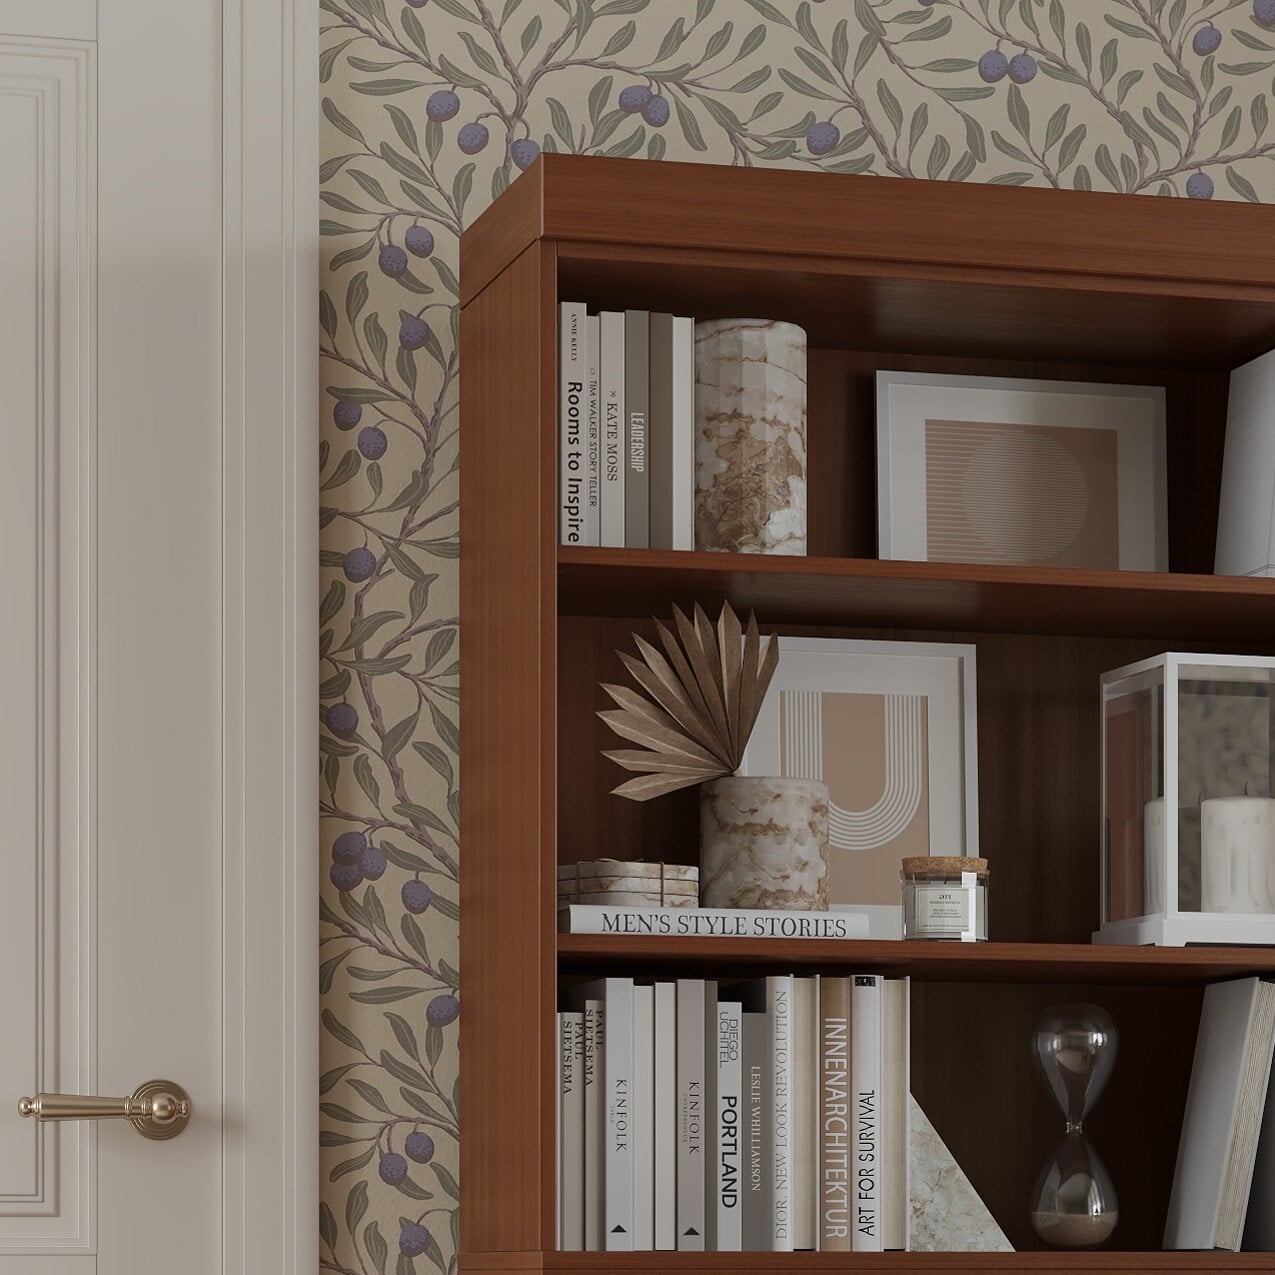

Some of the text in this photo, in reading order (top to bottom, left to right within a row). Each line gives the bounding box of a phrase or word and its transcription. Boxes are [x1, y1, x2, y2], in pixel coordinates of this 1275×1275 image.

[564, 381, 583, 543] Rooms to Inspire
[589, 380, 597, 507] TIM WALKER STORY TELLER
[607, 402, 617, 481] KATE MOSS
[631, 412, 644, 472] LEADERSHIP
[677, 914, 847, 937] STYLE STORIES
[563, 1021, 572, 1094] SIETSEMA
[575, 1022, 583, 1059] PAUL
[585, 1009, 593, 1085] SIETSEMA
[595, 1010, 603, 1049] PAUL
[729, 1019, 738, 1060] DIEGO
[616, 1079, 626, 1152] KINFOLK
[689, 1082, 699, 1154] KINFOLK
[751, 1066, 760, 1191] LESLIE WHILLIAMSON
[776, 991, 787, 1190] NEW LOOK REVOLUTION
[825, 1018, 847, 1237] INNENARCHITEKTUR
[721, 1096, 737, 1208] PORTLAND
[859, 1090, 874, 1236] ART FOR SURVIVAL
